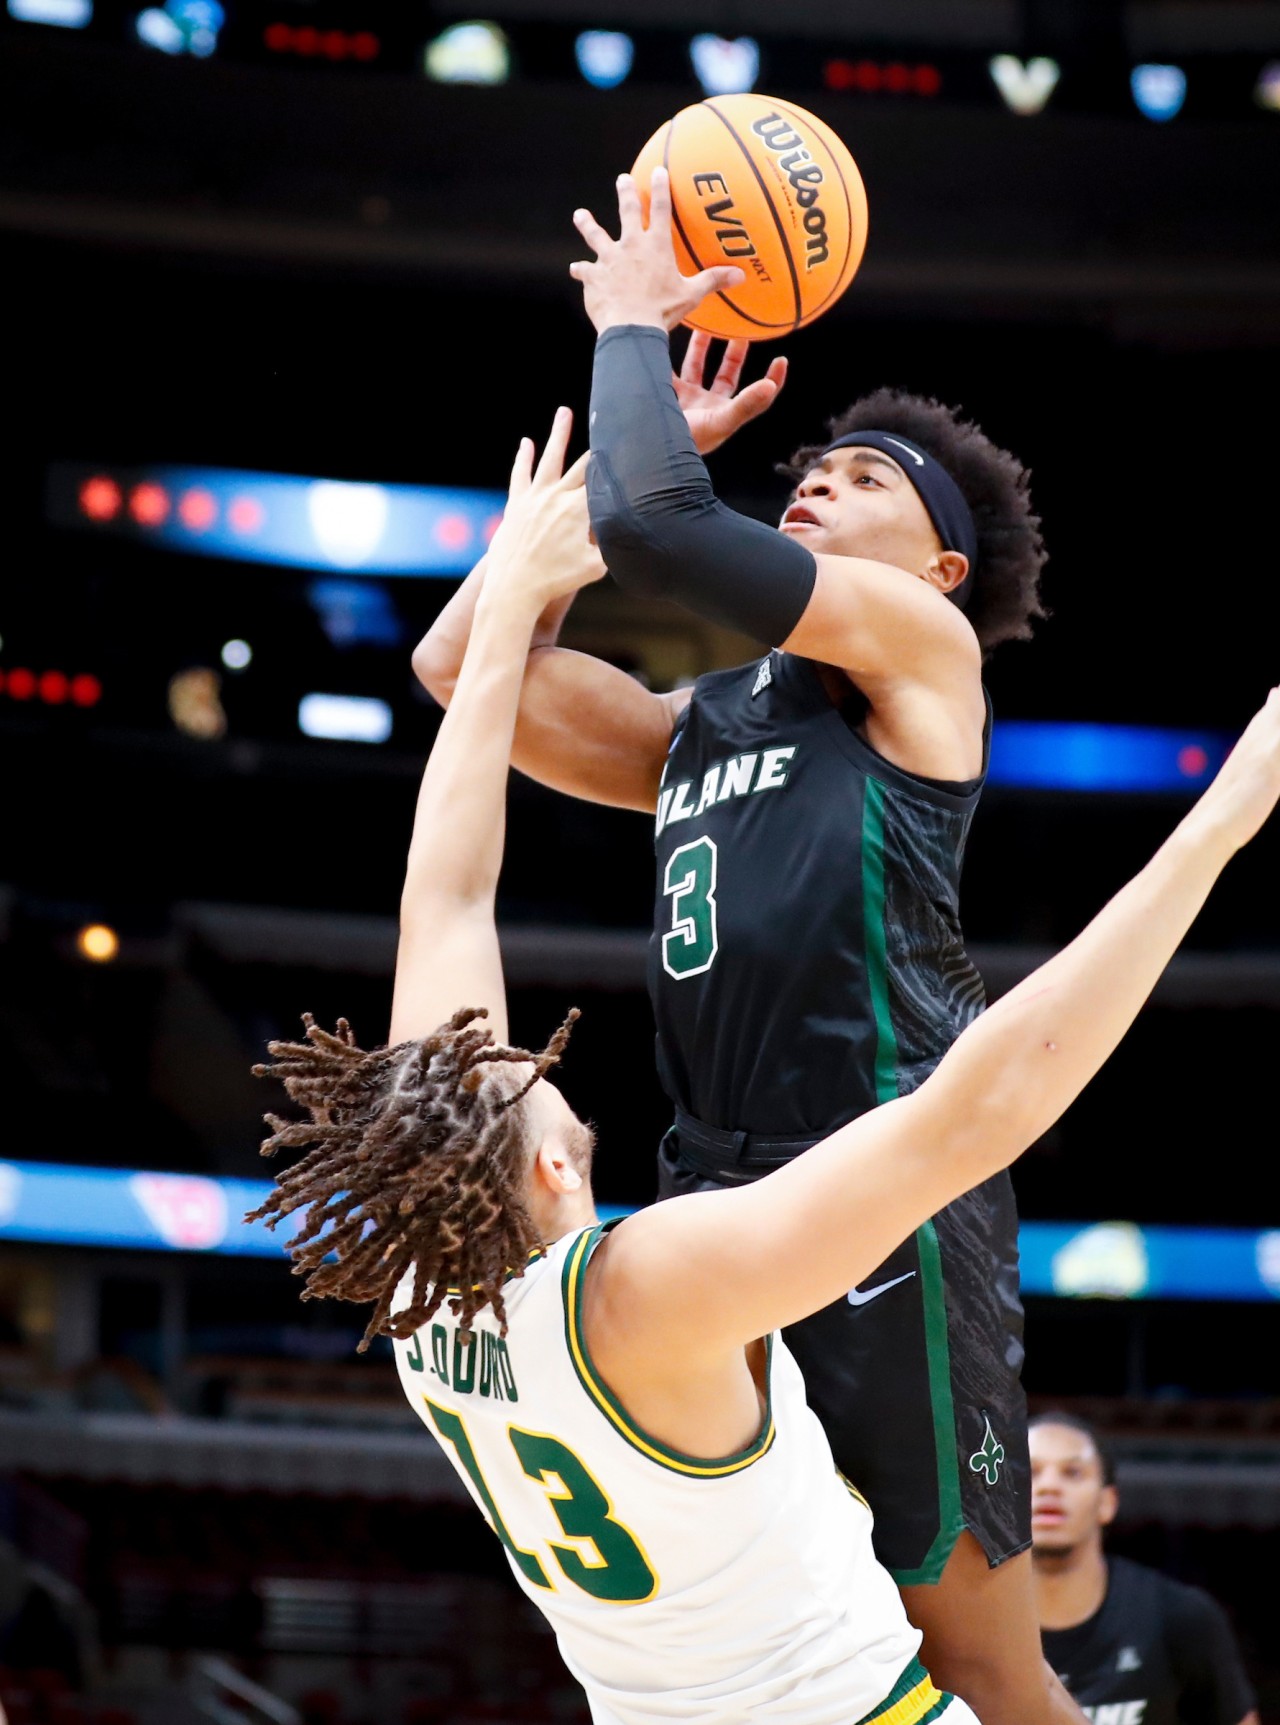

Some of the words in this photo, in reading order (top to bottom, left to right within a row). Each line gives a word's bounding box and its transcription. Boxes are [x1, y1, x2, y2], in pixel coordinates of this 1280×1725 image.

[752, 111, 829, 270] Wilson
[750, 257, 772, 283] NXT
[655, 744, 799, 838] ULANE
[662, 834, 719, 981] 3
[422, 1393, 661, 1605] 13
